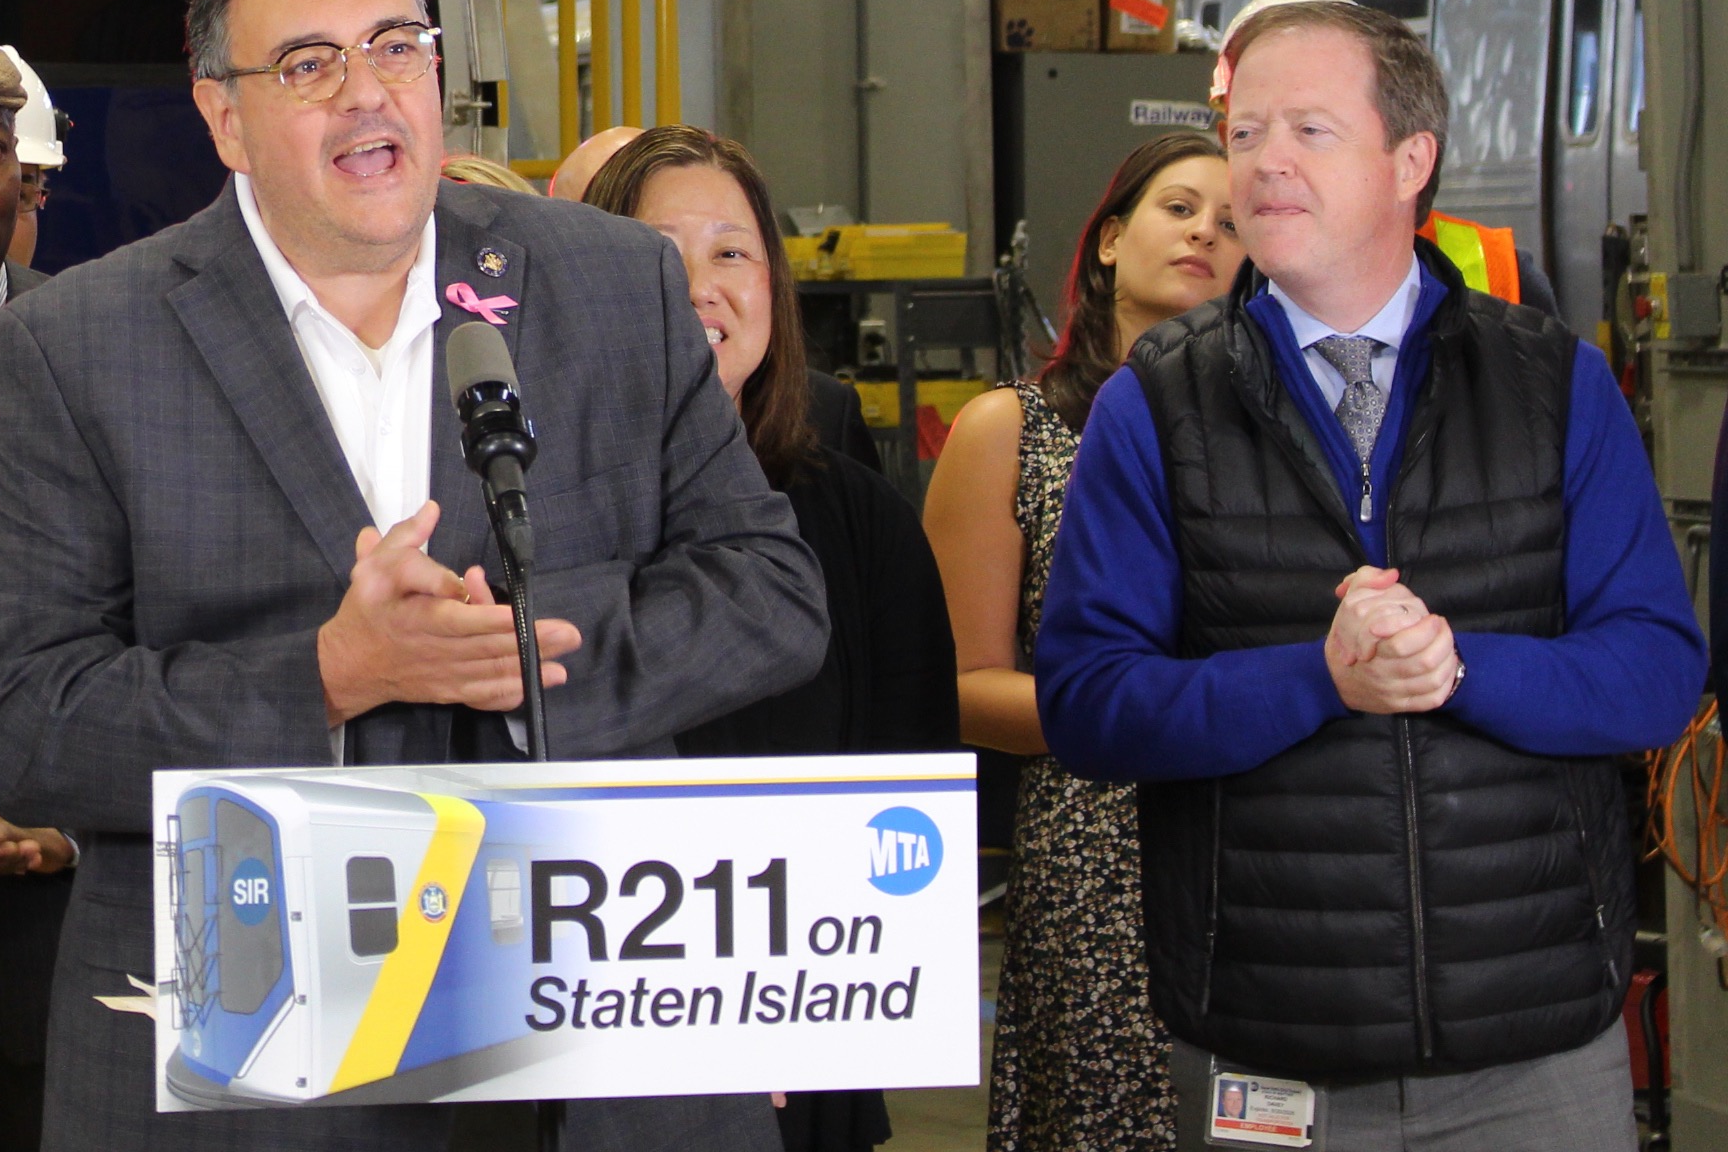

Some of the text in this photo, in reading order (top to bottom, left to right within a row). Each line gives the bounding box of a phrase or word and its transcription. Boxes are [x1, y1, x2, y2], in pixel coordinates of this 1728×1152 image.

[1134, 106, 1213, 127] Railway
[865, 825, 933, 880] MTA
[232, 877, 270, 906] SIR
[530, 857, 789, 965] R211
[807, 915, 883, 956] on
[524, 966, 920, 1033] Staten Island
[1240, 1123, 1277, 1132] EMPLOYEE
